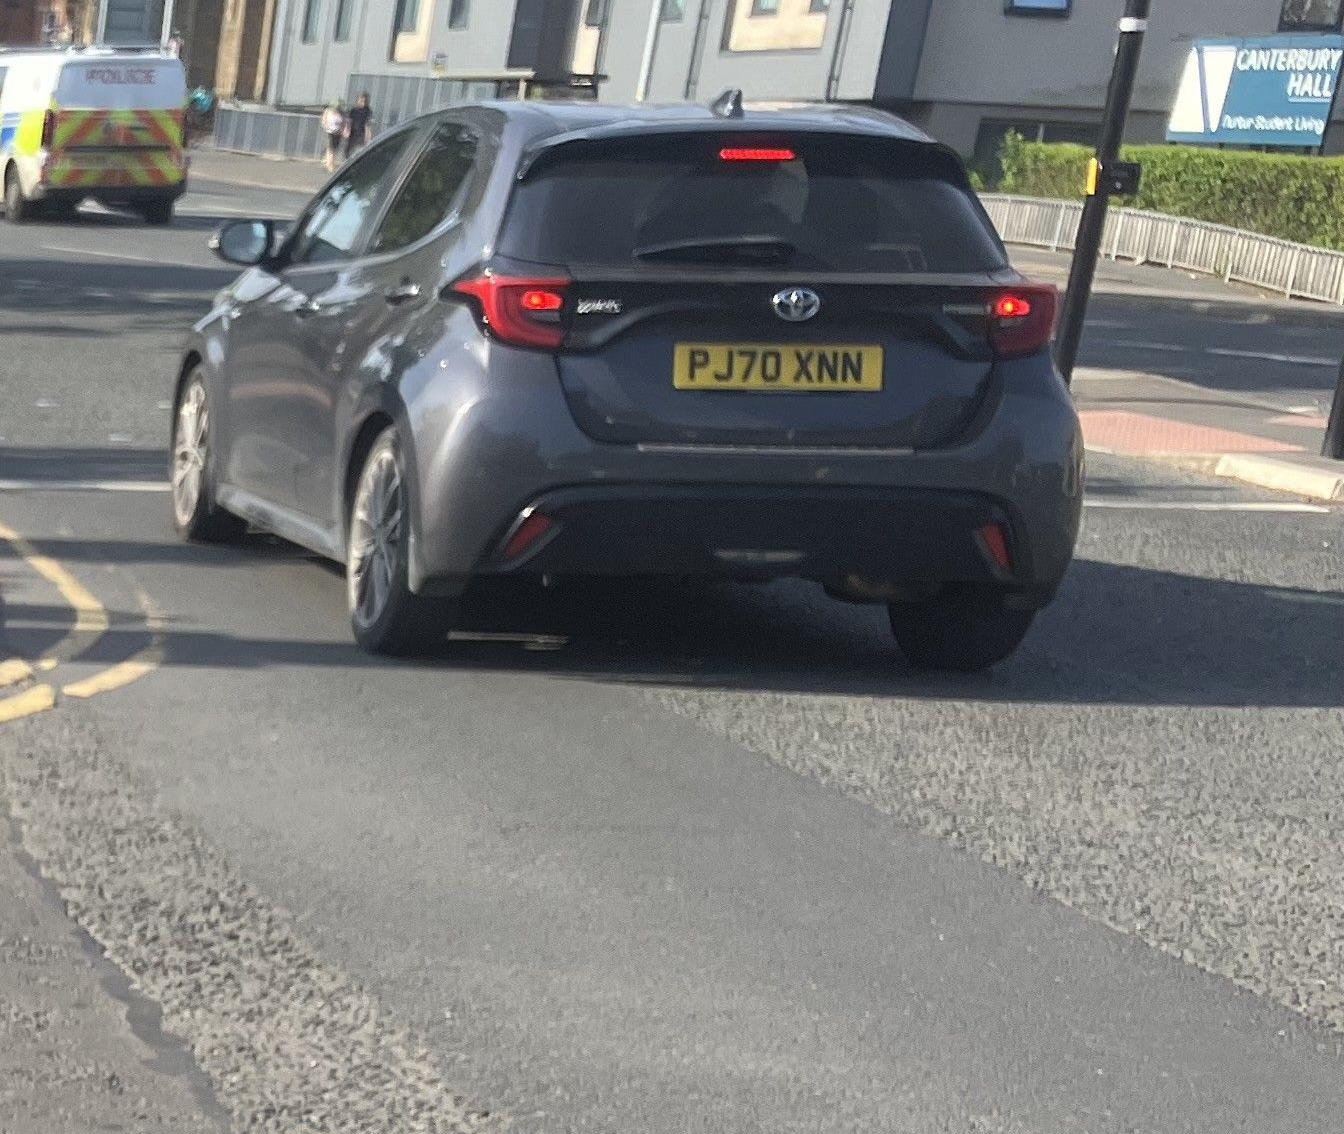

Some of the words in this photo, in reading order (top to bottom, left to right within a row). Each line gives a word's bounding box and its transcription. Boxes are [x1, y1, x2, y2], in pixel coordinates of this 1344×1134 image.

[1237, 48, 1343, 71] CANTERBURY
[1287, 72, 1332, 97] HALL
[687, 349, 782, 382] PJ70
[793, 350, 863, 384] XNN
